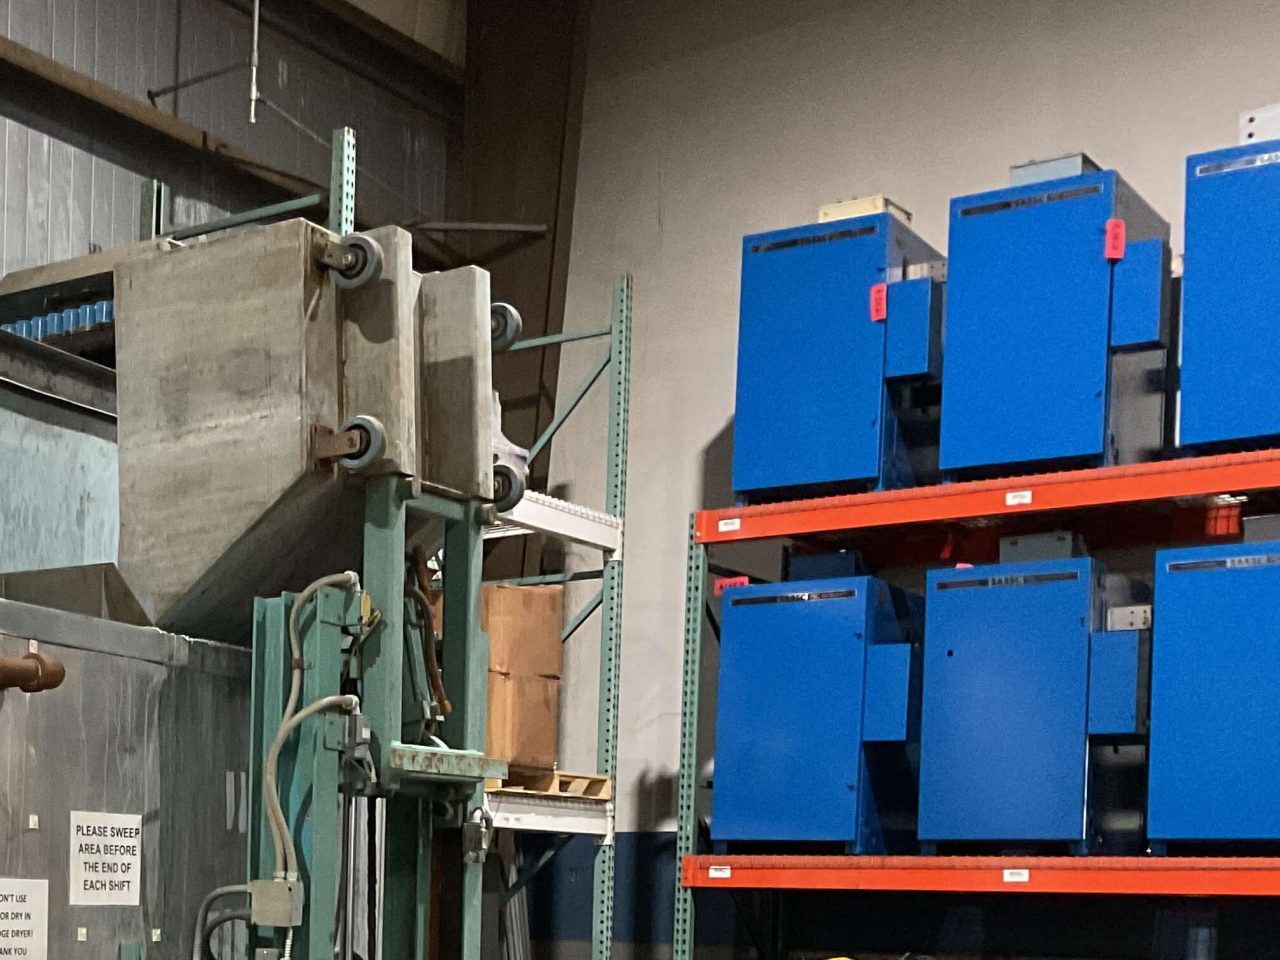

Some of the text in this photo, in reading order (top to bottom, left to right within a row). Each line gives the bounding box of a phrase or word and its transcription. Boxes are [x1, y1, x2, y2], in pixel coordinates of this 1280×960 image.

[76, 824, 140, 839] PLEASE SWEEP
[78, 843, 137, 857] AREA BEFORE
[83, 861, 132, 874] THE END OF
[83, 879, 132, 892] EACH SHIFT
[15, 894, 28, 903] USE
[10, 911, 23, 921] DRY
[24, 912, 31, 921] IN
[10, 929, 34, 939] DRYER!
[13, 947, 28, 956] YOU
